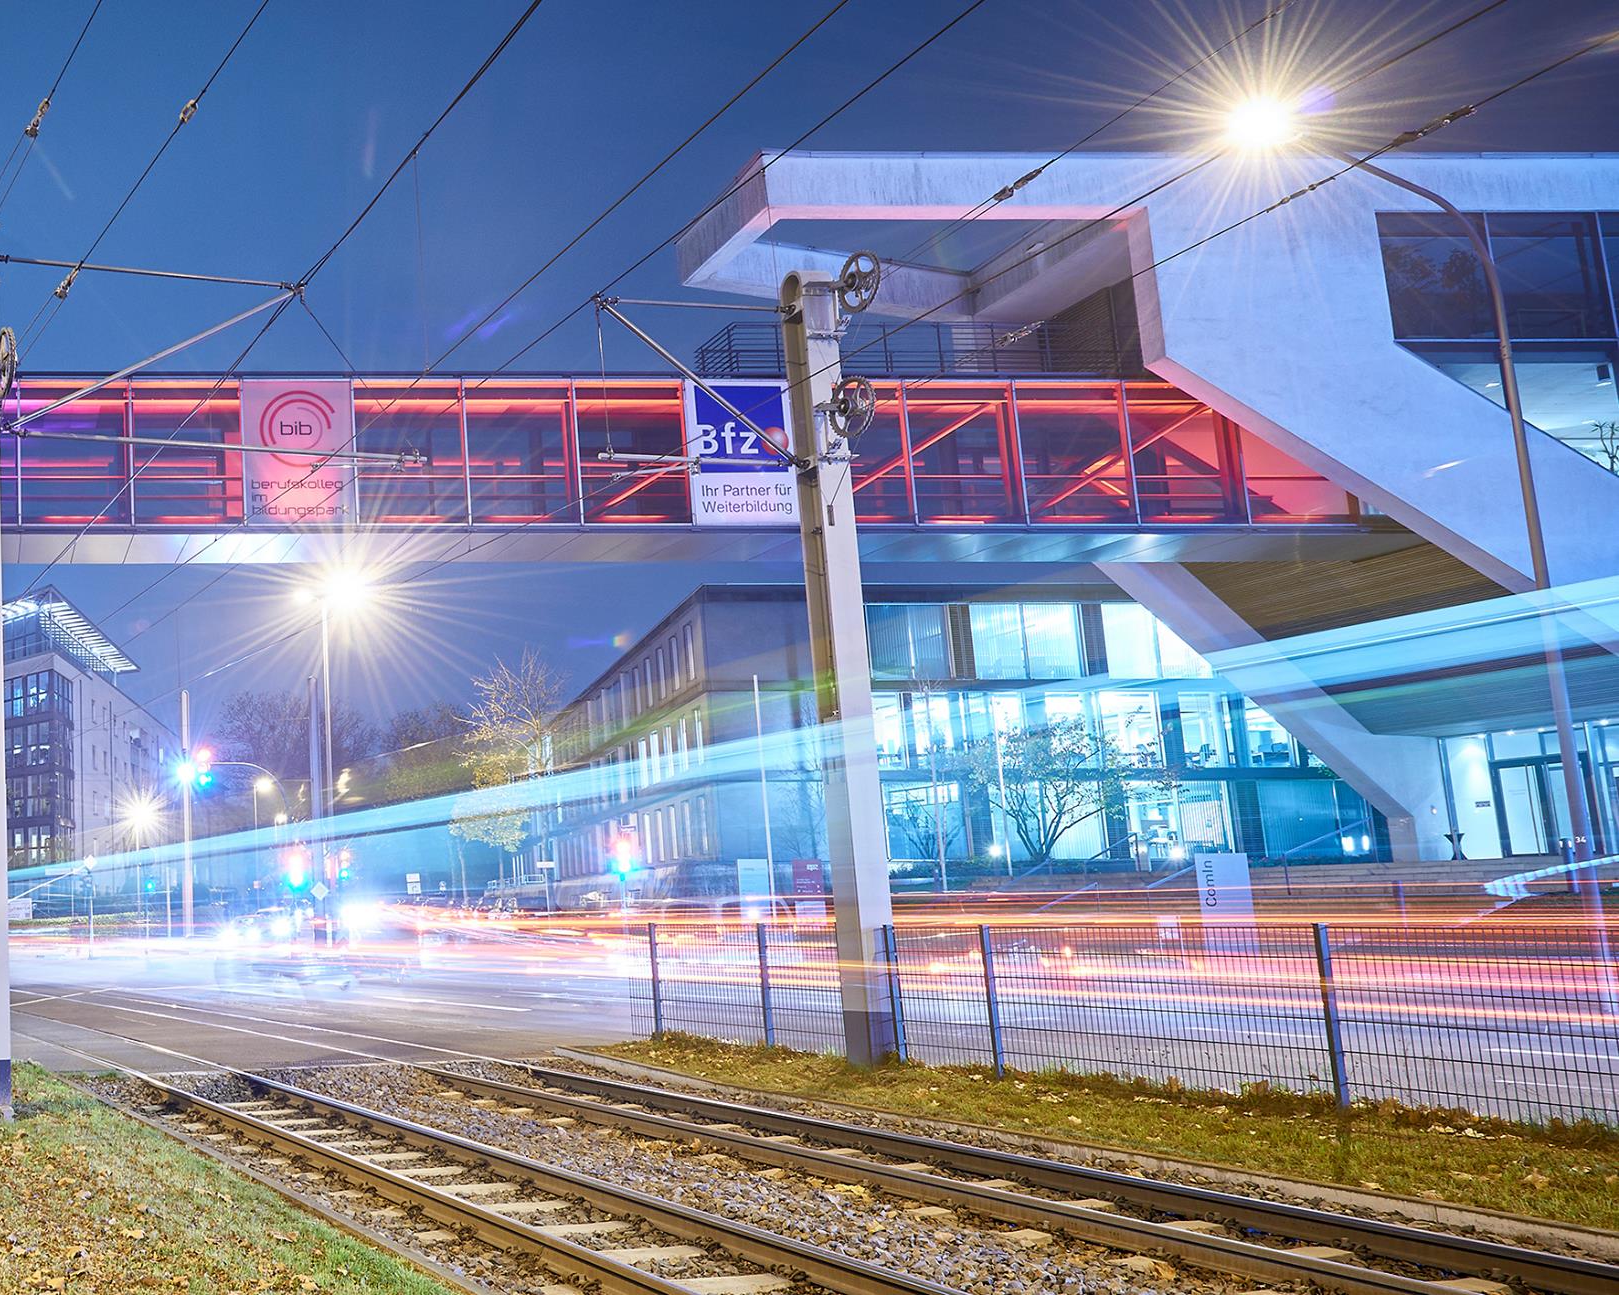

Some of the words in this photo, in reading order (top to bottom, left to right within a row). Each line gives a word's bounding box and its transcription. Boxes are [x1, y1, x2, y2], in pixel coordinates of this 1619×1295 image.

[280, 421, 313, 436] bib
[698, 421, 759, 455] Bfz
[251, 479, 344, 491] berufskolleg
[701, 485, 719, 497] Ihr
[723, 484, 771, 496] Partner
[774, 483, 792, 496] für
[252, 494, 268, 502] im
[252, 505, 350, 516] bildungspark
[702, 500, 793, 514] Weiterbildung
